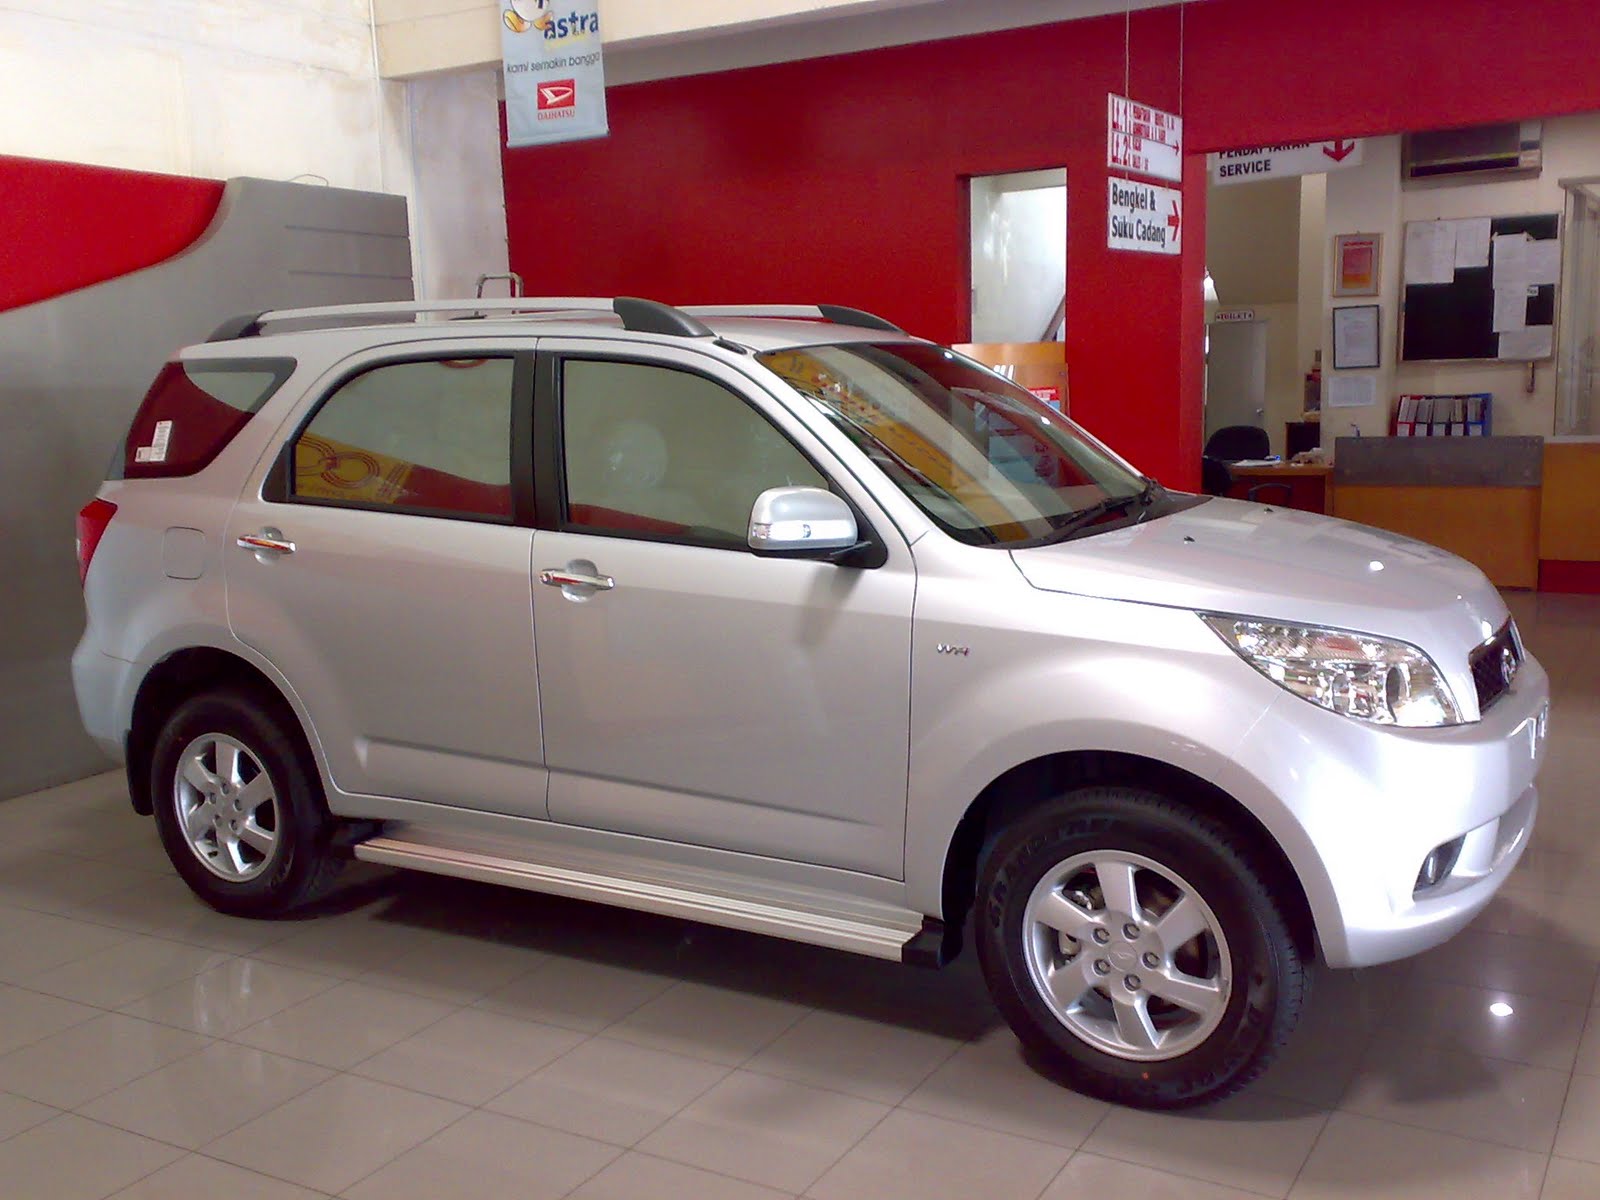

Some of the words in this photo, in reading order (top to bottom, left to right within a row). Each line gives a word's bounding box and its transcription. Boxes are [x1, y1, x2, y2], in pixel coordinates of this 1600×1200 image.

[544, 11, 598, 39] astra
[507, 62, 529, 72] kami
[531, 58, 566, 71] semakin
[569, 52, 600, 66] bangga
[538, 110, 575, 120] DAIHATSU
[1220, 160, 1271, 177] SERVICE
[1112, 183, 1147, 213] Bengkel
[1150, 190, 1156, 211] &
[1112, 215, 1134, 239] Suku
[1136, 218, 1166, 248] Cadang
